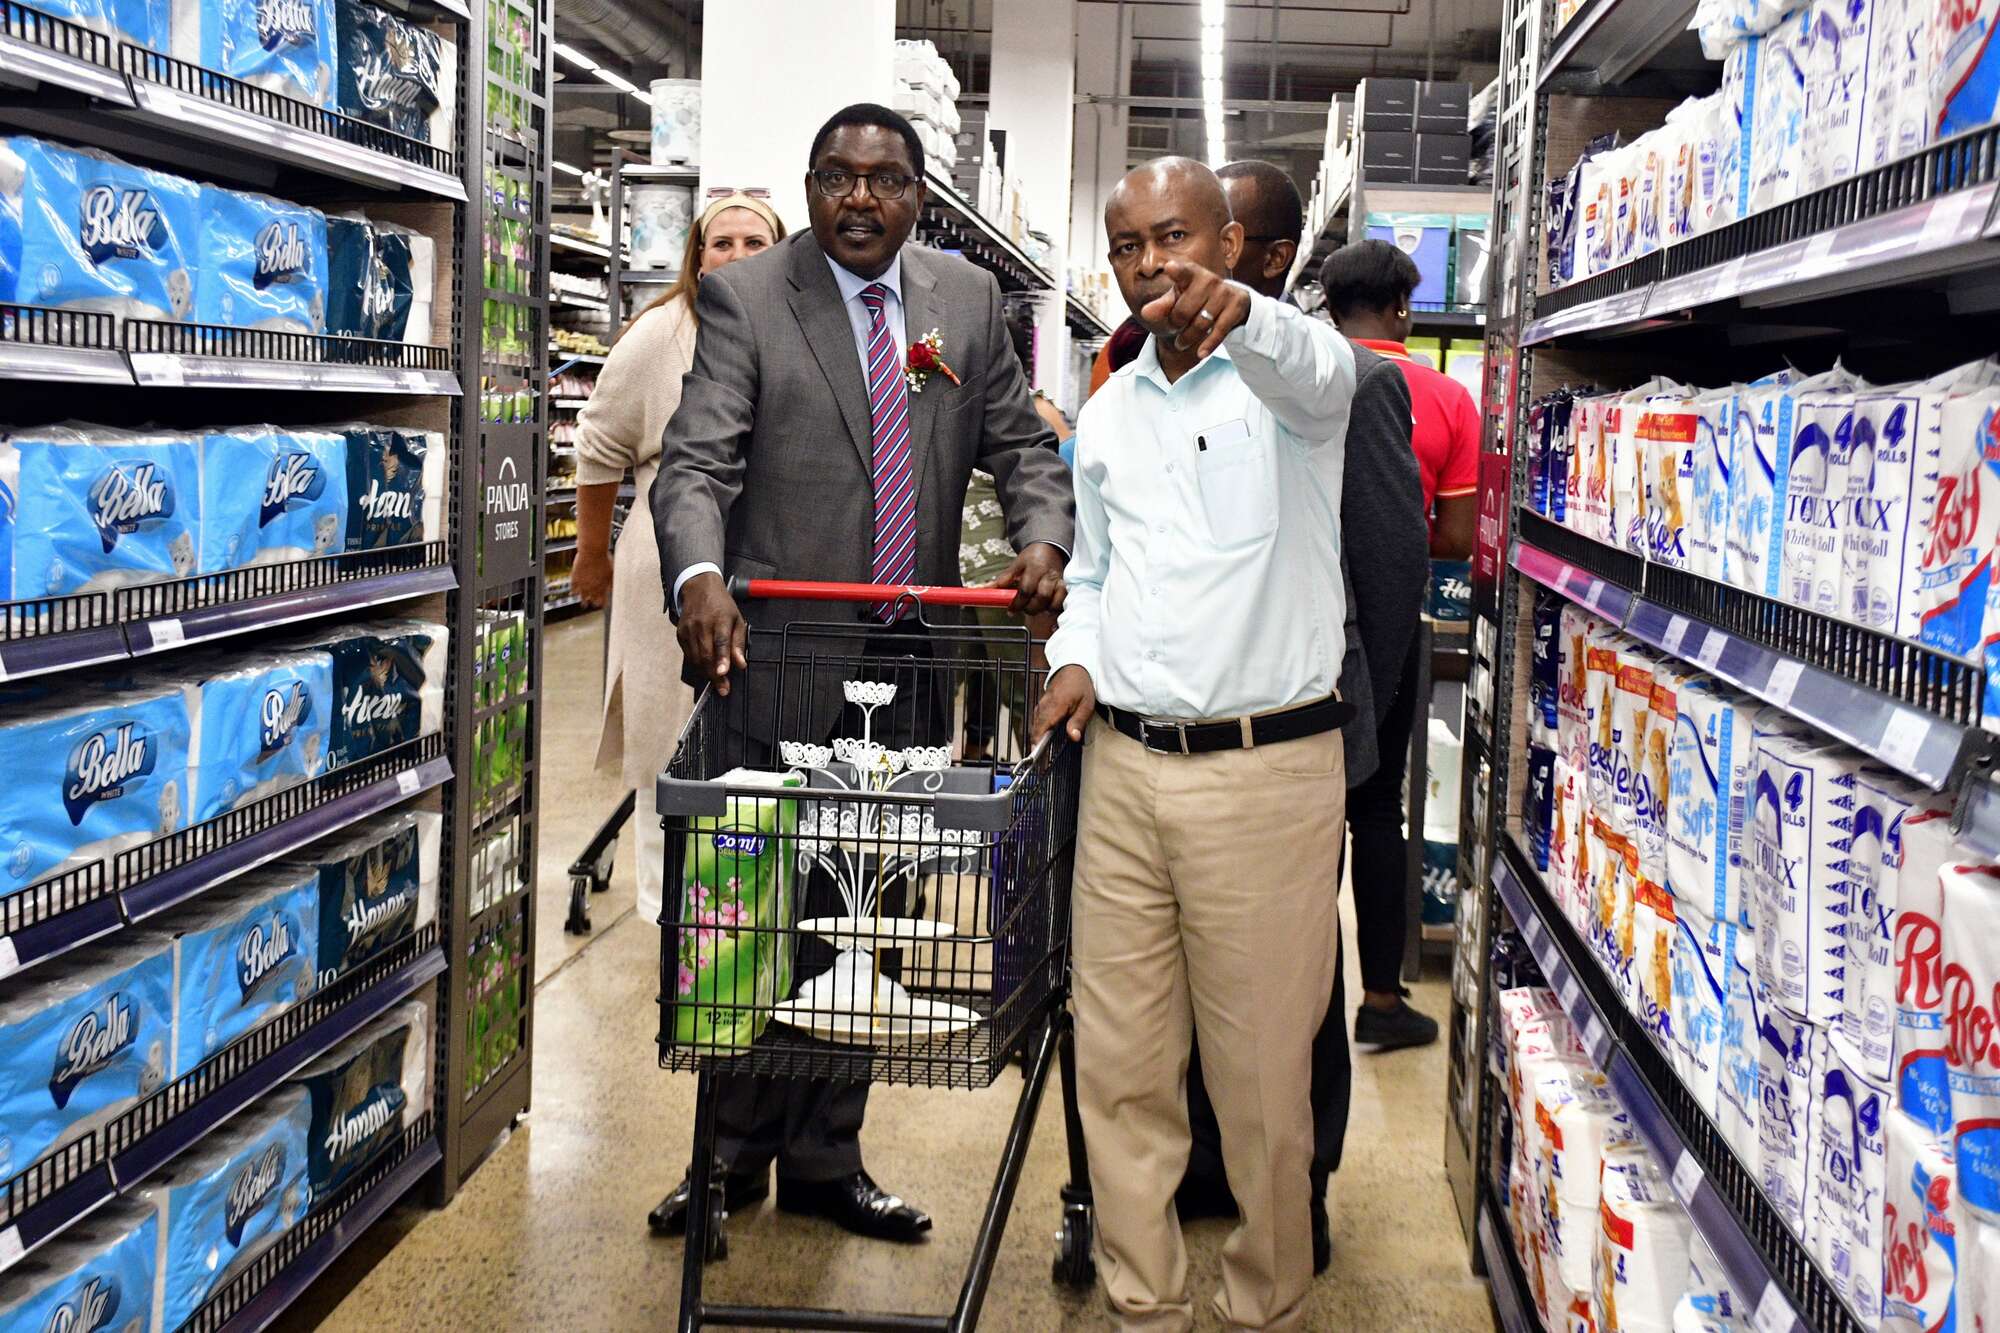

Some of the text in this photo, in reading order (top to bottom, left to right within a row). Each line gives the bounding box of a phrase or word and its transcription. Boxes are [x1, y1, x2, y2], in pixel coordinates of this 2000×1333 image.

[1606, 408, 1613, 425] 4
[1719, 403, 1728, 425] 4
[1762, 401, 1773, 424] 4
[1834, 411, 1854, 452] 4
[1882, 402, 1908, 449] 4
[1683, 450, 1693, 468] 4
[95, 464, 166, 528] Bella
[486, 483, 529, 515] PANDA
[494, 521, 519, 542] STORES
[1707, 713, 1716, 734] 4
[70, 722, 147, 800] Bella
[1566, 776, 1574, 792] 4
[1783, 772, 1803, 812] 4
[717, 834, 765, 856] Comfy
[1754, 838, 1797, 890] TOILEX
[347, 892, 406, 945] Hanan
[243, 911, 289, 986] Bella
[704, 1011, 721, 1024] 12
[58, 992, 130, 1084] Bella
[324, 1098, 394, 1162] Hanan
[1859, 1093, 1880, 1137] 4
[229, 1142, 279, 1227] Bella
